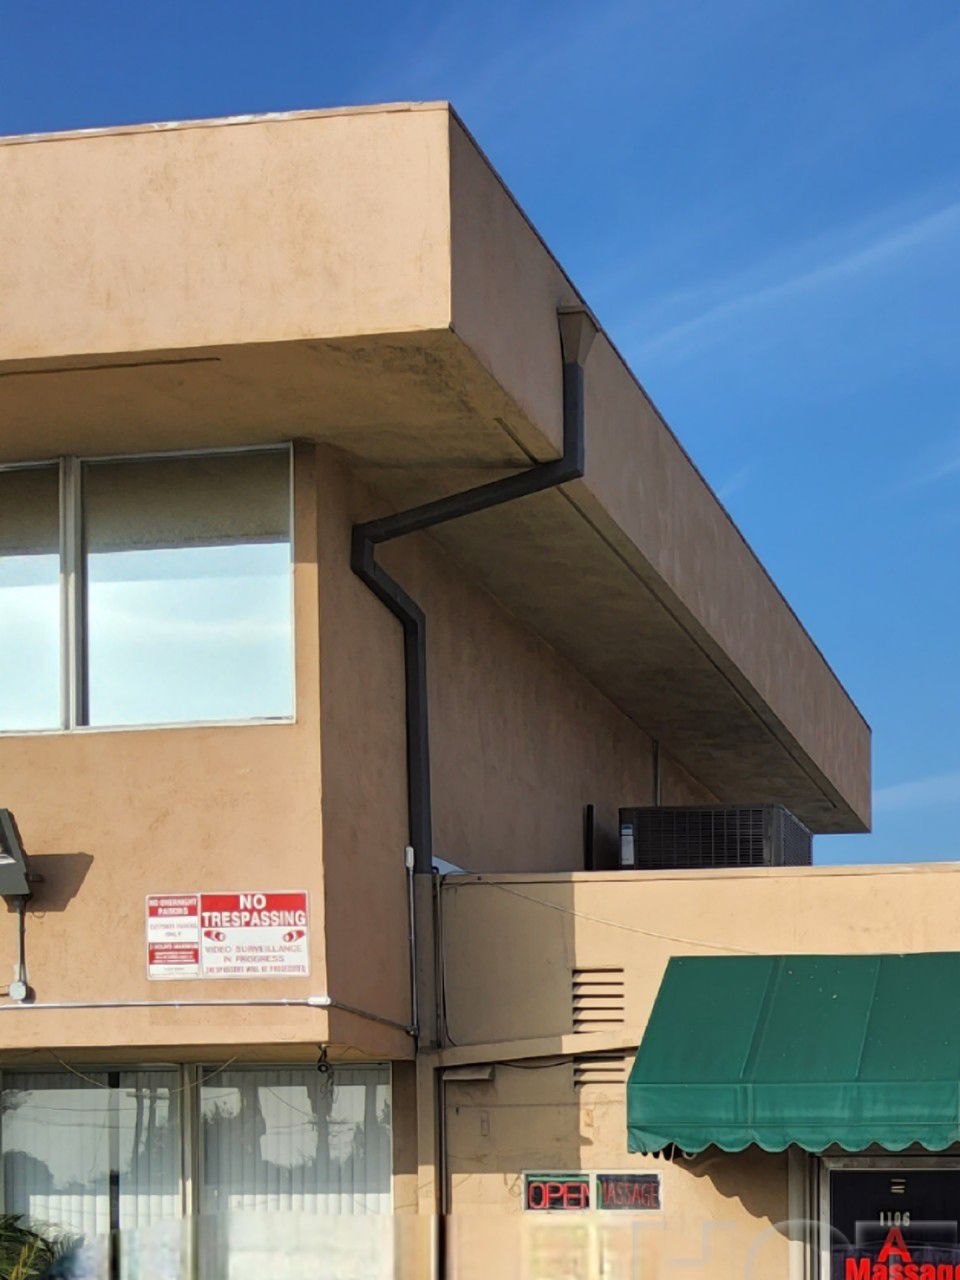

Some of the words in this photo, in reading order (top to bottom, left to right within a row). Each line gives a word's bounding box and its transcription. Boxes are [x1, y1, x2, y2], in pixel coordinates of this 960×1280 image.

[240, 895, 266, 910] NO
[201, 910, 306, 927] TRESPASSING
[205, 946, 231, 954] VIDEO
[236, 944, 303, 953] SURVEILLANCE
[235, 954, 285, 962] PROGRESS
[528, 1182, 589, 1209] OPEN
[880, 1212, 910, 1227] 1106
[877, 1226, 912, 1262] A
